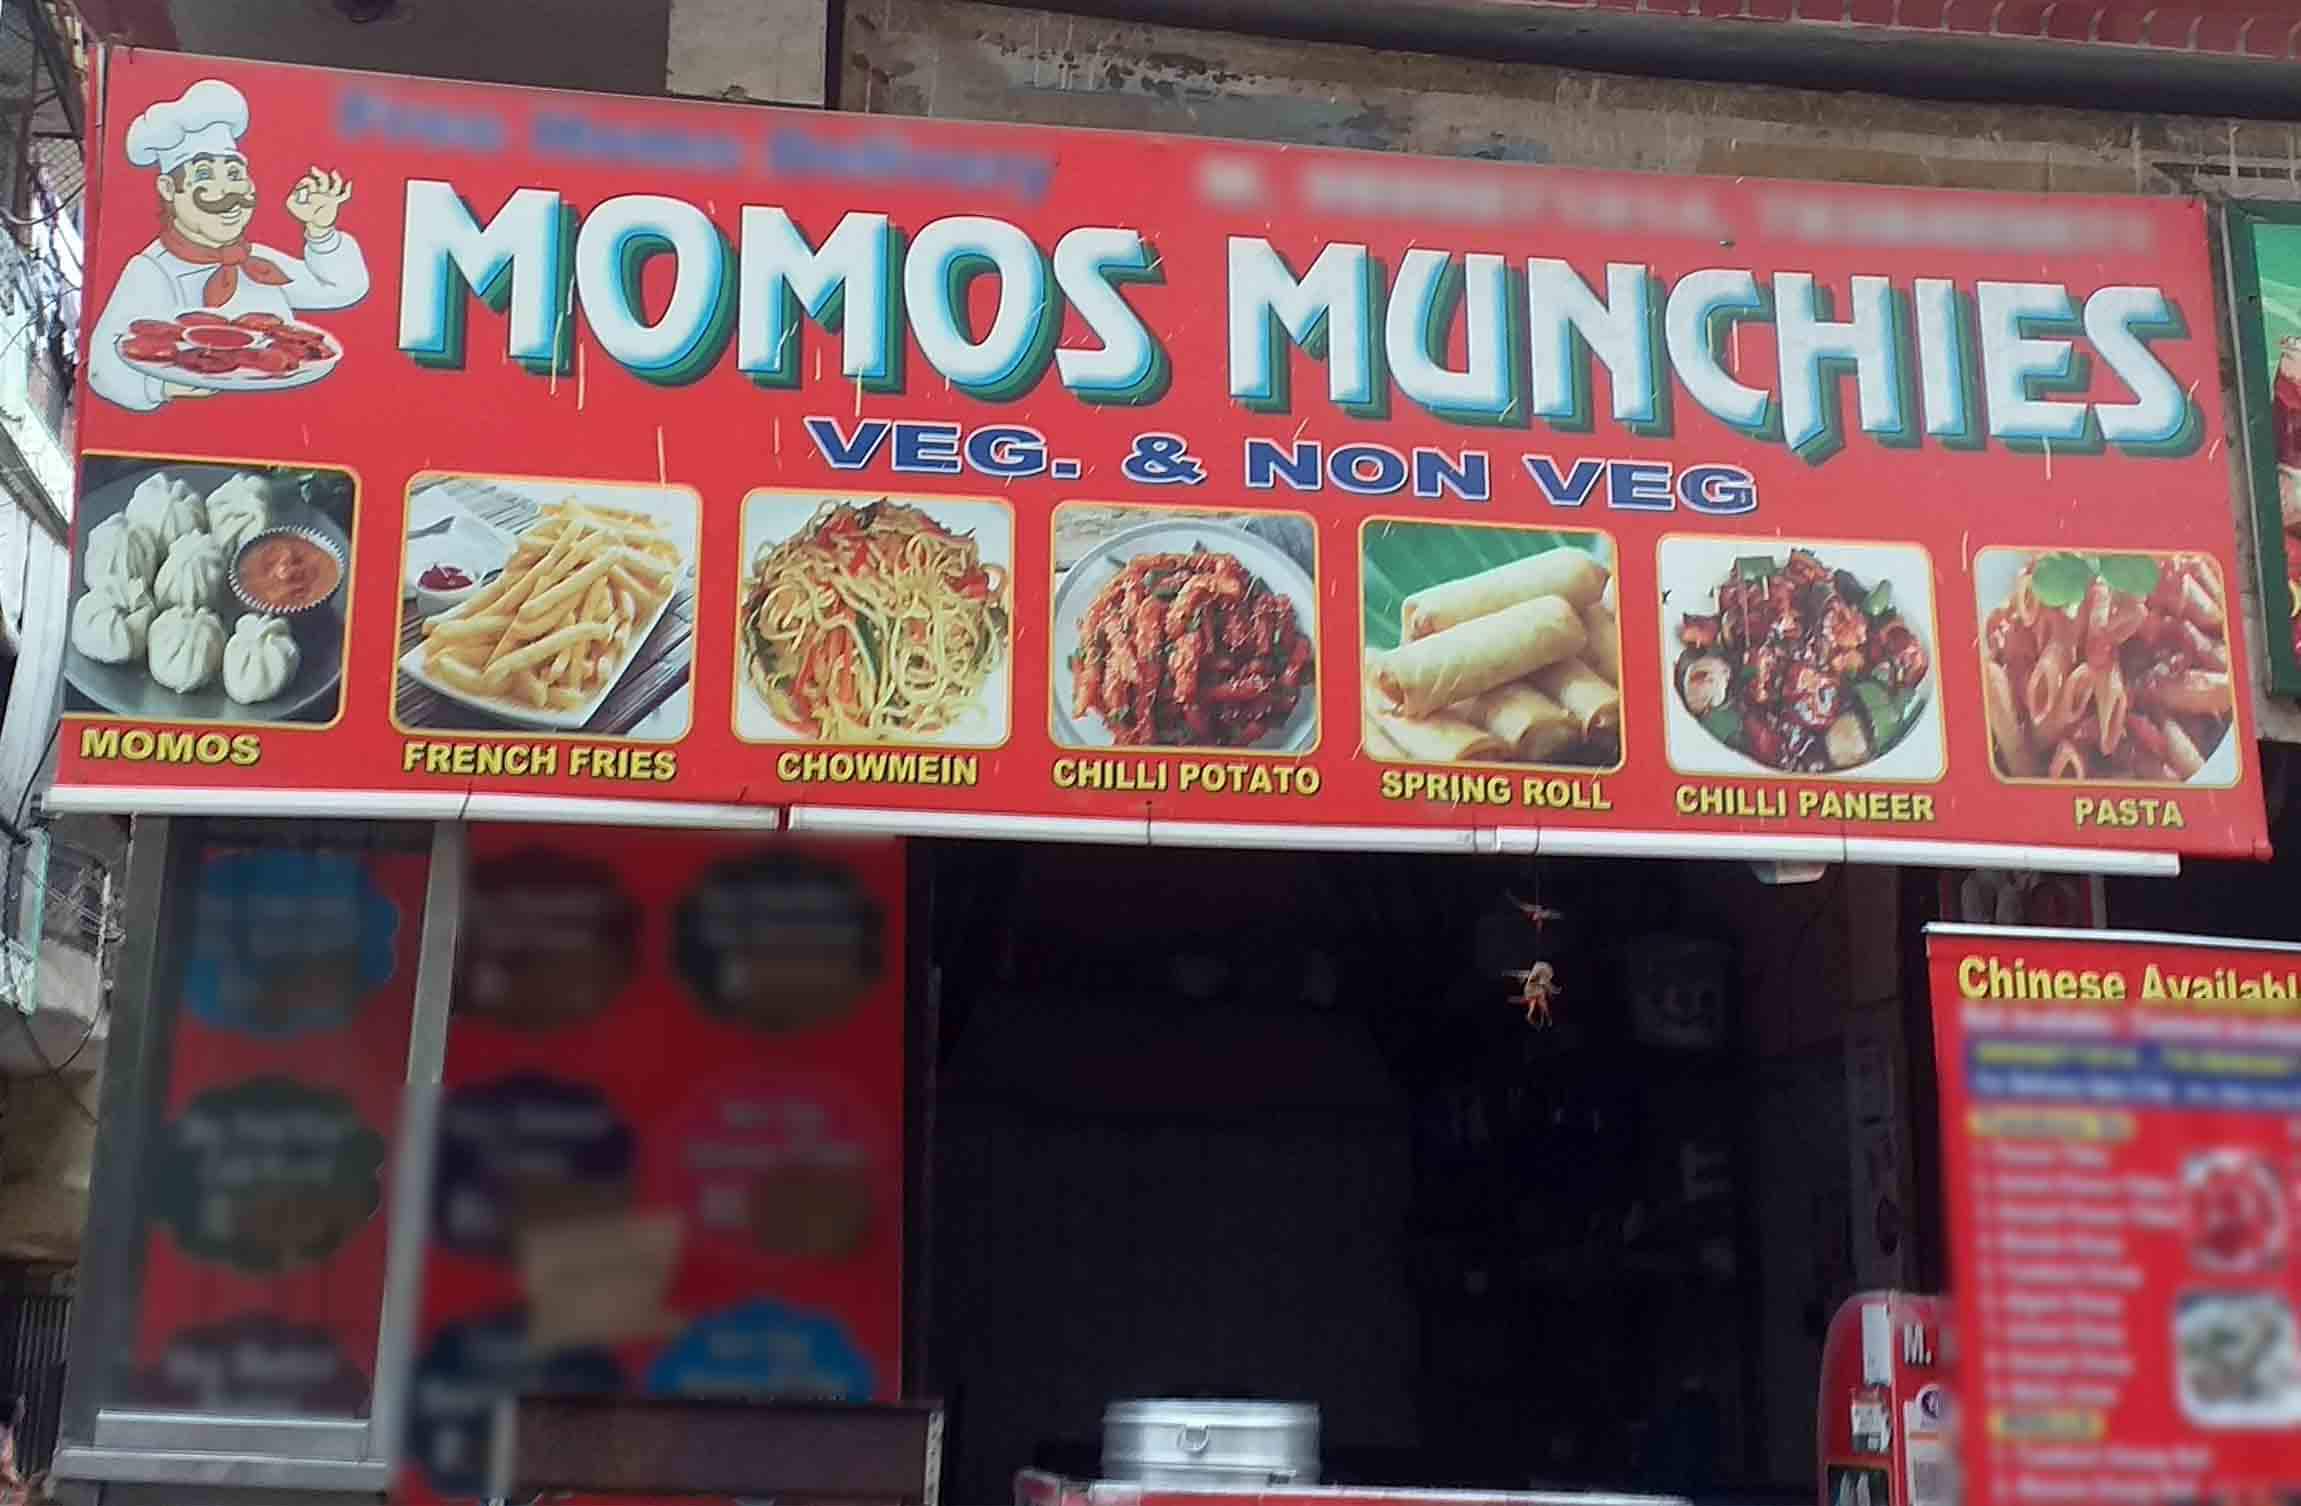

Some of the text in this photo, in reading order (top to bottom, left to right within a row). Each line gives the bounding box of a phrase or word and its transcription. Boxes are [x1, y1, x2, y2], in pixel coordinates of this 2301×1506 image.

[397, 178, 1172, 405] MOMOS
[1227, 235, 2206, 464] MUNCHIES
[802, 416, 1758, 514] VEG. & NON VEG
[80, 728, 262, 766] MOMOS
[403, 742, 678, 782] FRENCH FRIES
[776, 751, 978, 786] CHOWMEIN
[1052, 759, 1321, 795] CHILLI POTATO
[1381, 769, 1613, 811] SPRING ROLL
[1675, 785, 1936, 823] CHILLI PANEER
[2073, 796, 2187, 829] PASTA
[1957, 955, 2127, 1002] Chinese
